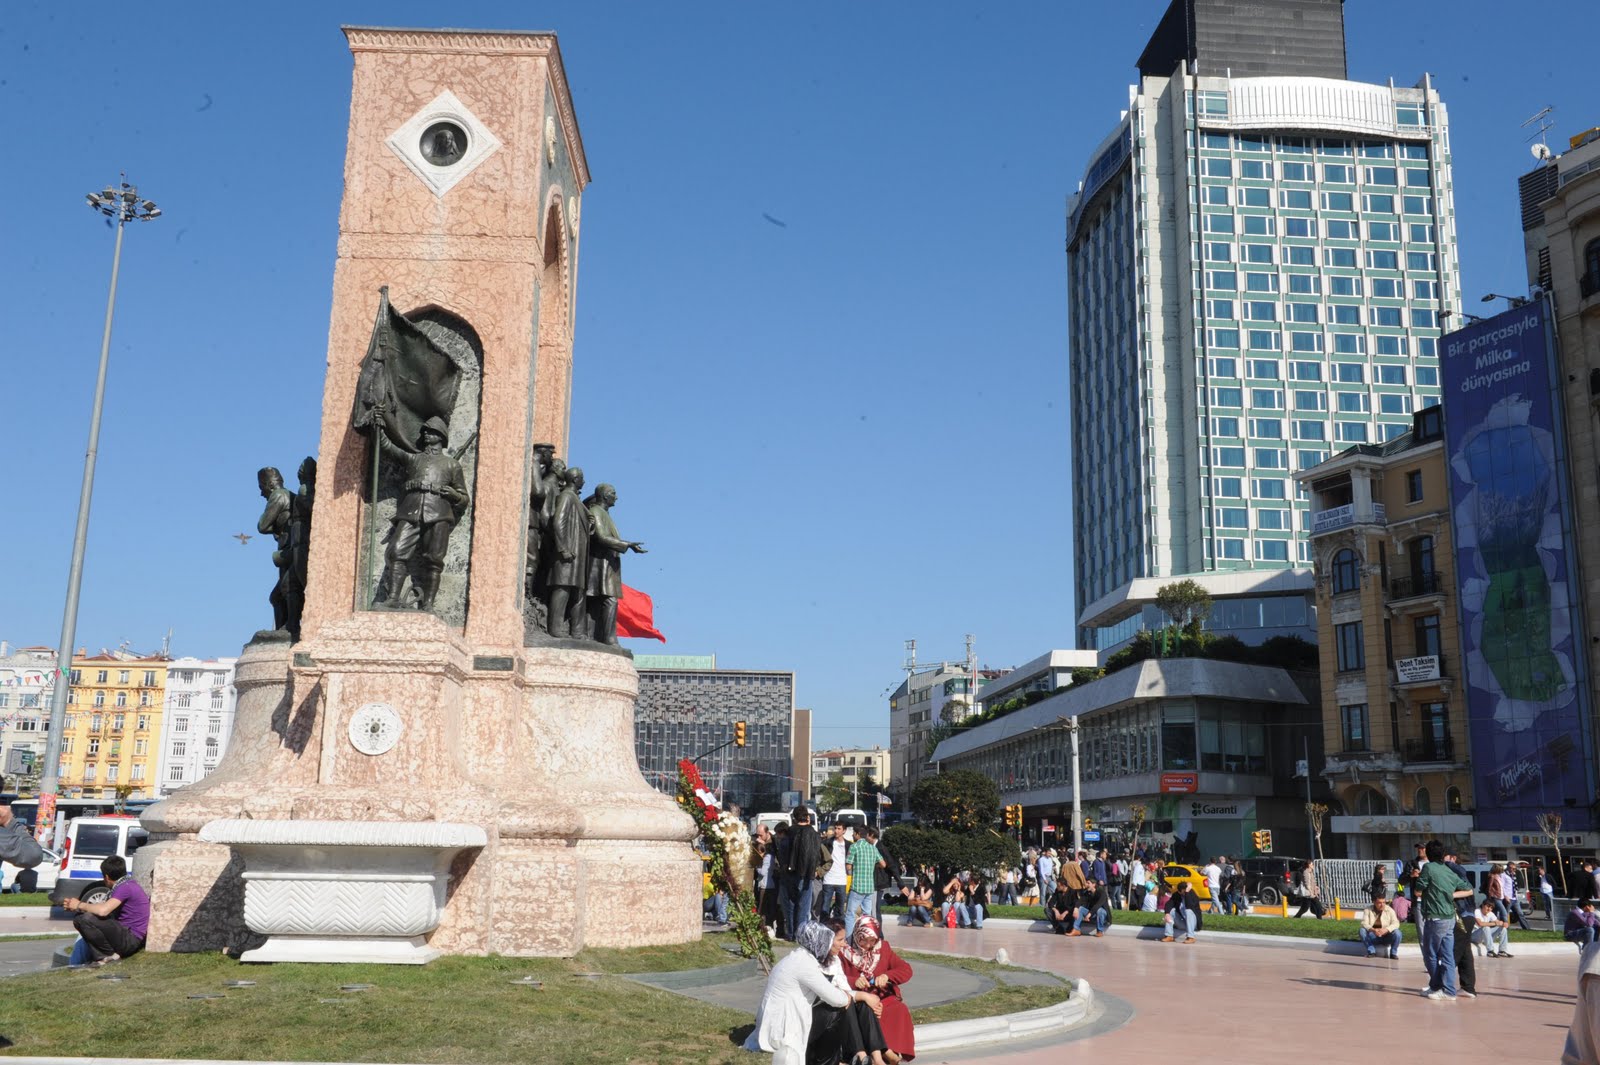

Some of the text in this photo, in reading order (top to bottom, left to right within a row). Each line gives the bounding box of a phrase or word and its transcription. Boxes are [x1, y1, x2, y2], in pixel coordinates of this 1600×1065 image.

[1448, 315, 1538, 357] Bir parçasıyla
[1475, 349, 1512, 370] Milka
[1461, 360, 1530, 392] dünyasına
[1414, 657, 1435, 666] Taksim
[1202, 804, 1238, 815] Garanti
